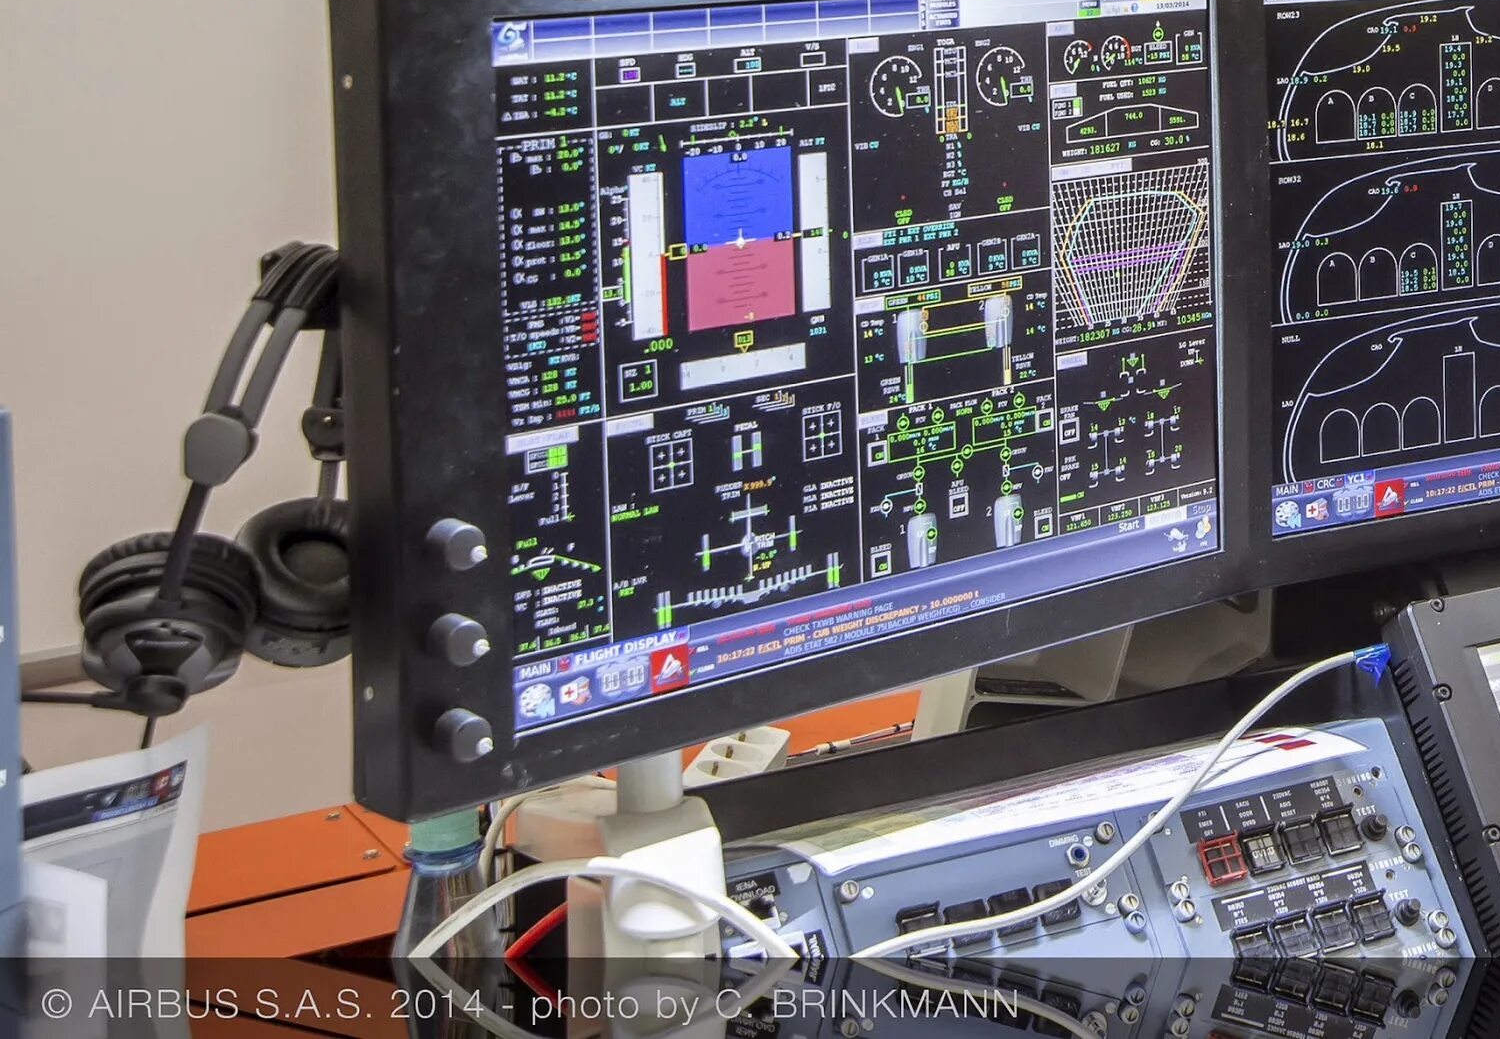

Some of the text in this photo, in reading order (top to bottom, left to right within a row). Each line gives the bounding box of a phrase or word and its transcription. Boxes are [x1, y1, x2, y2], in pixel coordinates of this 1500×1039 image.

[1317, 479, 1335, 489] CRC
[1348, 473, 1365, 483] YC1
[1276, 485, 1298, 496] MAIN
[1118, 520, 1139, 532] Start
[574, 632, 677, 666] FLIGHT DISPLAY
[520, 662, 551, 678] MAIN
[1356, 805, 1376, 816] TEST
[1049, 834, 1079, 848] DIMMING
[1075, 867, 1092, 879] TEST
[735, 879, 758, 891] IENA
[729, 885, 776, 902] OWNLOAD
[1389, 889, 1409, 901] TEST
